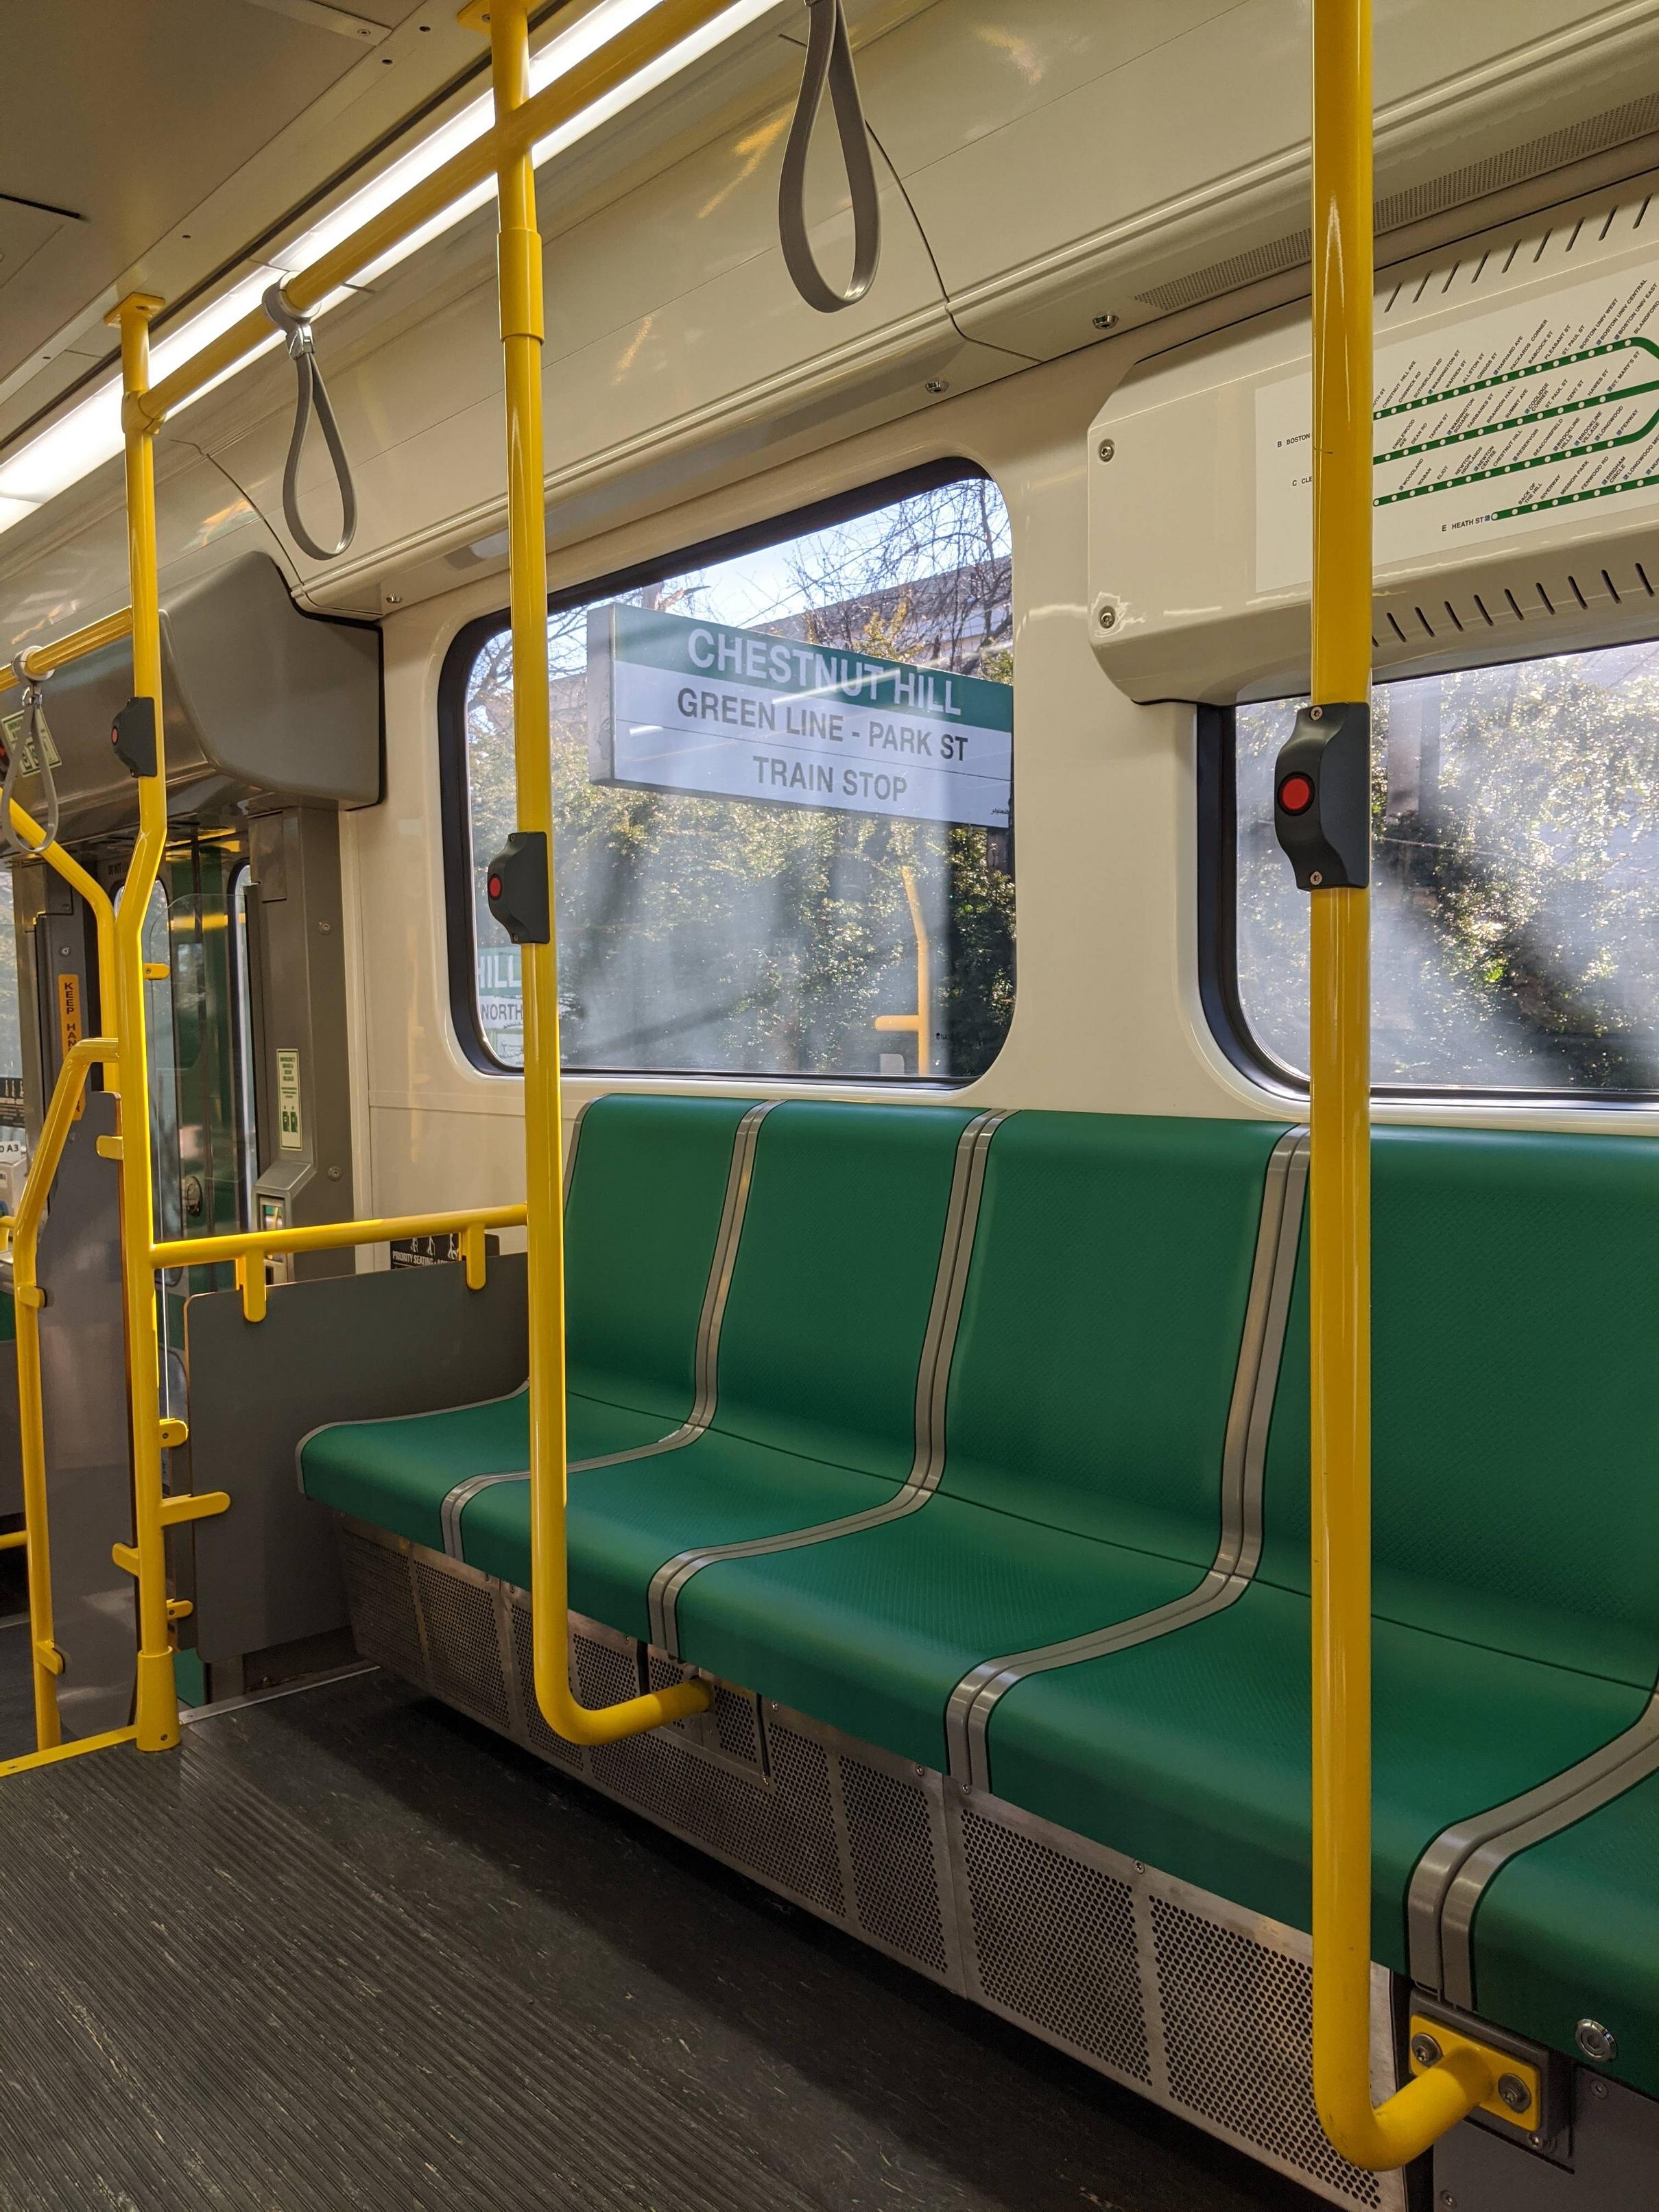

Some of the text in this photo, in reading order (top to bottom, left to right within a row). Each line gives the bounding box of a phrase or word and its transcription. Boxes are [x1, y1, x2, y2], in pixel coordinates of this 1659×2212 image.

[1600, 279, 1647, 340] BOSTON UNIV CENTRAL
[1619, 283, 1658, 335] BOSTON UNIV EAST
[1568, 333, 1579, 347] PAUL
[1578, 325, 1585, 333] ST
[1579, 298, 1619, 350] BOSTON UNIV WEST
[1497, 335, 1523, 370] HARVARD AVE
[1509, 320, 1548, 370] PACKARDS CORNER
[1528, 339, 1548, 364] BABCOCK
[1544, 324, 1571, 360] PLEASANT ST
[1633, 351, 1640, 359] ST
[1431, 357, 1455, 389] WASHINGTON
[1445, 359, 1467, 389] WARREN ST
[1462, 352, 1485, 383] ALLSTON ST
[1383, 383, 1400, 408] CHESTNUT
[1400, 372, 1409, 382] HILL
[1398, 379, 1416, 402] CHISWICK
[1413, 365, 1437, 398] SUTHERLAND
[1551, 387, 1562, 400] PAUL
[1562, 378, 1568, 387] ST
[1566, 379, 1584, 402] KENT ST
[1588, 369, 1609, 396] HAWES ST
[1450, 398, 1475, 430] WASHINGTON
[1486, 385, 1516, 423] BRANDON HALL
[1505, 389, 1529, 418] SUMMIT AVE
[1531, 390, 1549, 411] CORNER
[1429, 420, 1444, 439] TAPPAN
[1454, 412, 1470, 433] SQUARE
[1556, 417, 1580, 446] BROOKLINE
[1578, 411, 1603, 441] BROOKLINE
[1582, 422, 1600, 443] VILLAGE
[1599, 406, 1623, 436] LONGWOOD
[1621, 409, 1638, 431] FENWAY
[1286, 433, 1311, 445] BOSTON
[1411, 431, 1422, 444] DEAN
[1493, 429, 1523, 466] CHESTNUT HILL
[1516, 429, 1539, 457] RESERVOIR
[1560, 435, 1573, 450] HILLS
[1455, 455, 1471, 475] NEWTON
[1477, 446, 1494, 467] NEWTON
[1481, 450, 1496, 470] CENTRE
[1606, 456, 1626, 480] BRIGHAM
[1627, 445, 1653, 475] LONGWOOD
[1403, 458, 1424, 485] WOODLAND
[1418, 468, 1432, 485] WABAN
[1437, 466, 1448, 480] ELIOT
[1560, 460, 1589, 495] MISSION PARK
[1581, 456, 1609, 490] FENWOOD RD
[1610, 464, 1626, 483] CIRCLE
[1518, 490, 1530, 505] BACK
[1524, 483, 1542, 504] THE HILL
[1540, 474, 1562, 500] RIVERWAY
[1452, 519, 1474, 529] HEATH
[1475, 516, 1484, 525] ST
[687, 627, 962, 717] CHESTNUT HILL
[677, 687, 776, 732] GREEN
[785, 706, 844, 743] LINE
[869, 721, 932, 756] PARK
[940, 733, 970, 762] ST
[752, 755, 908, 802] TRAIN STOP
[64, 983, 76, 1052] KEEP HAN
[481, 1003, 523, 1020] NORTH
[6, 1144, 19, 1152] A3
